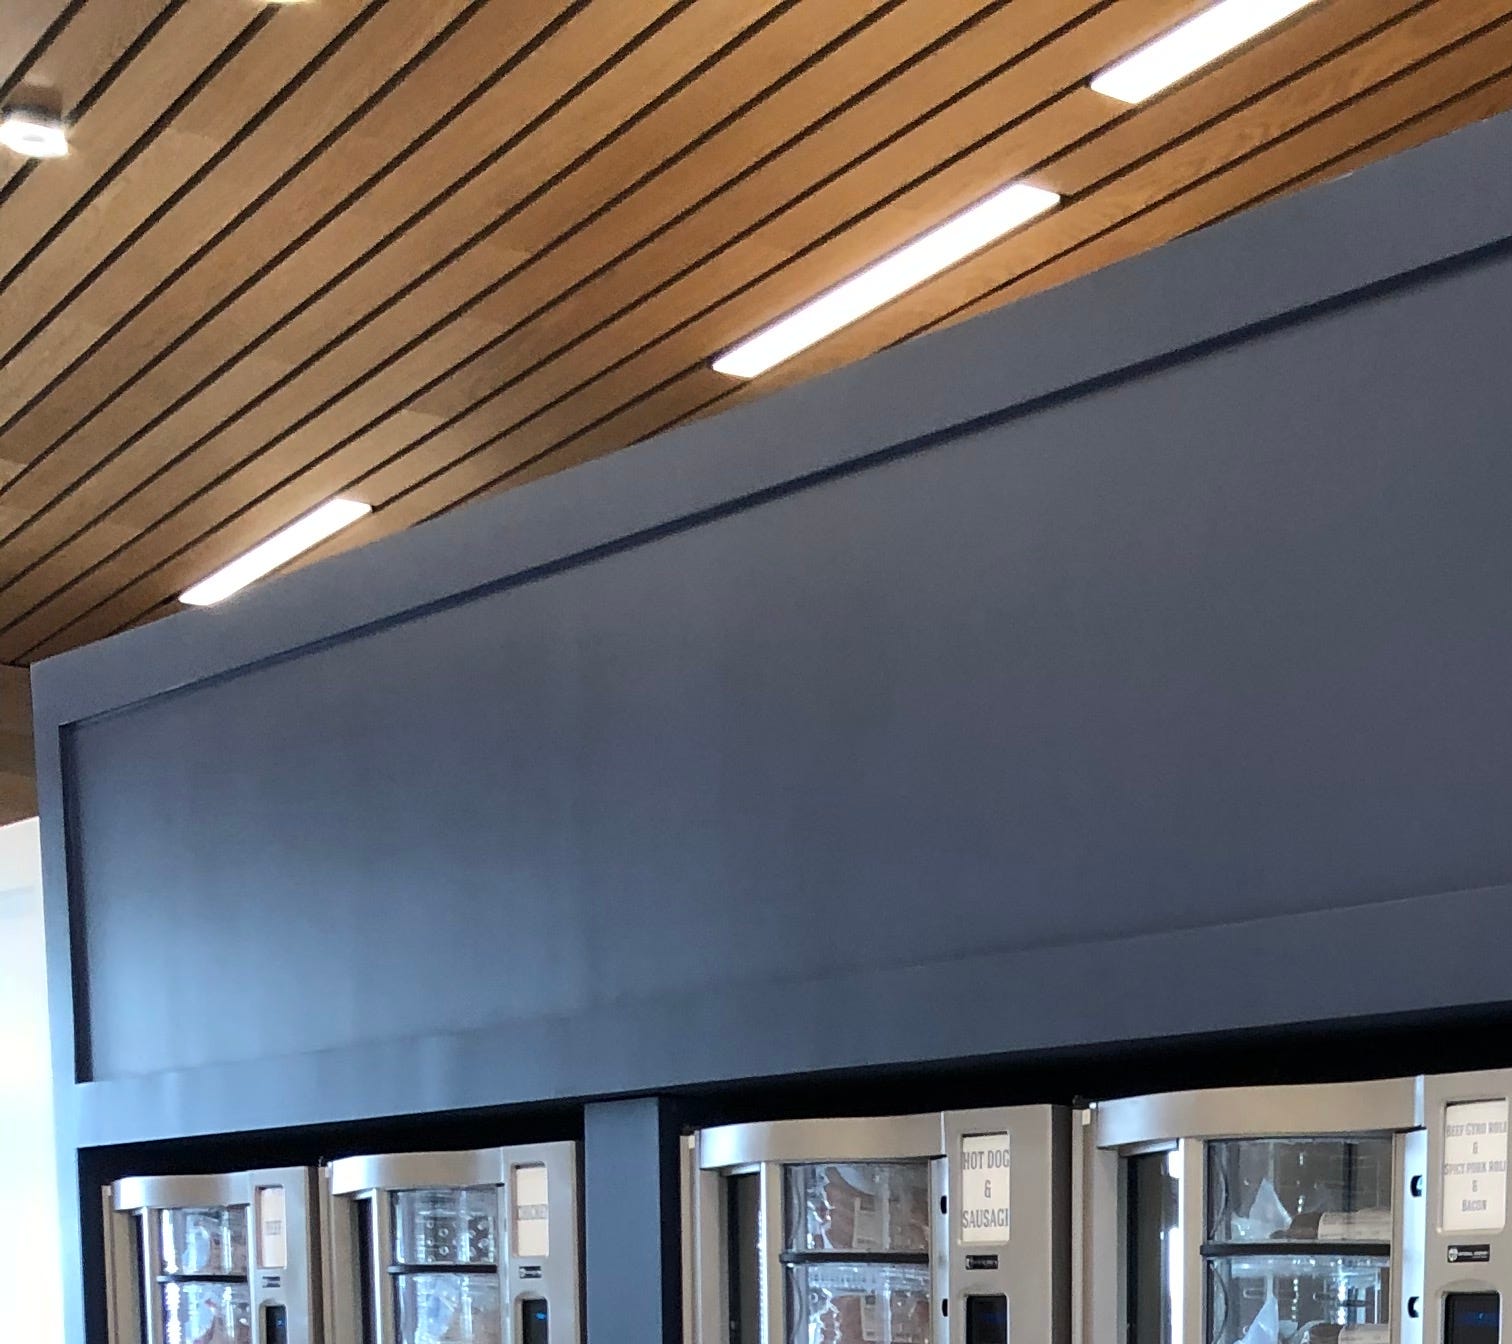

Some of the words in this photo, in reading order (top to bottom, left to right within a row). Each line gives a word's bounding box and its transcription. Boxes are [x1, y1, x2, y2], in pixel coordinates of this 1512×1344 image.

[963, 1151, 985, 1170] HOT
[984, 1179, 991, 1198] &
[1462, 1199, 1487, 1212] BACON
